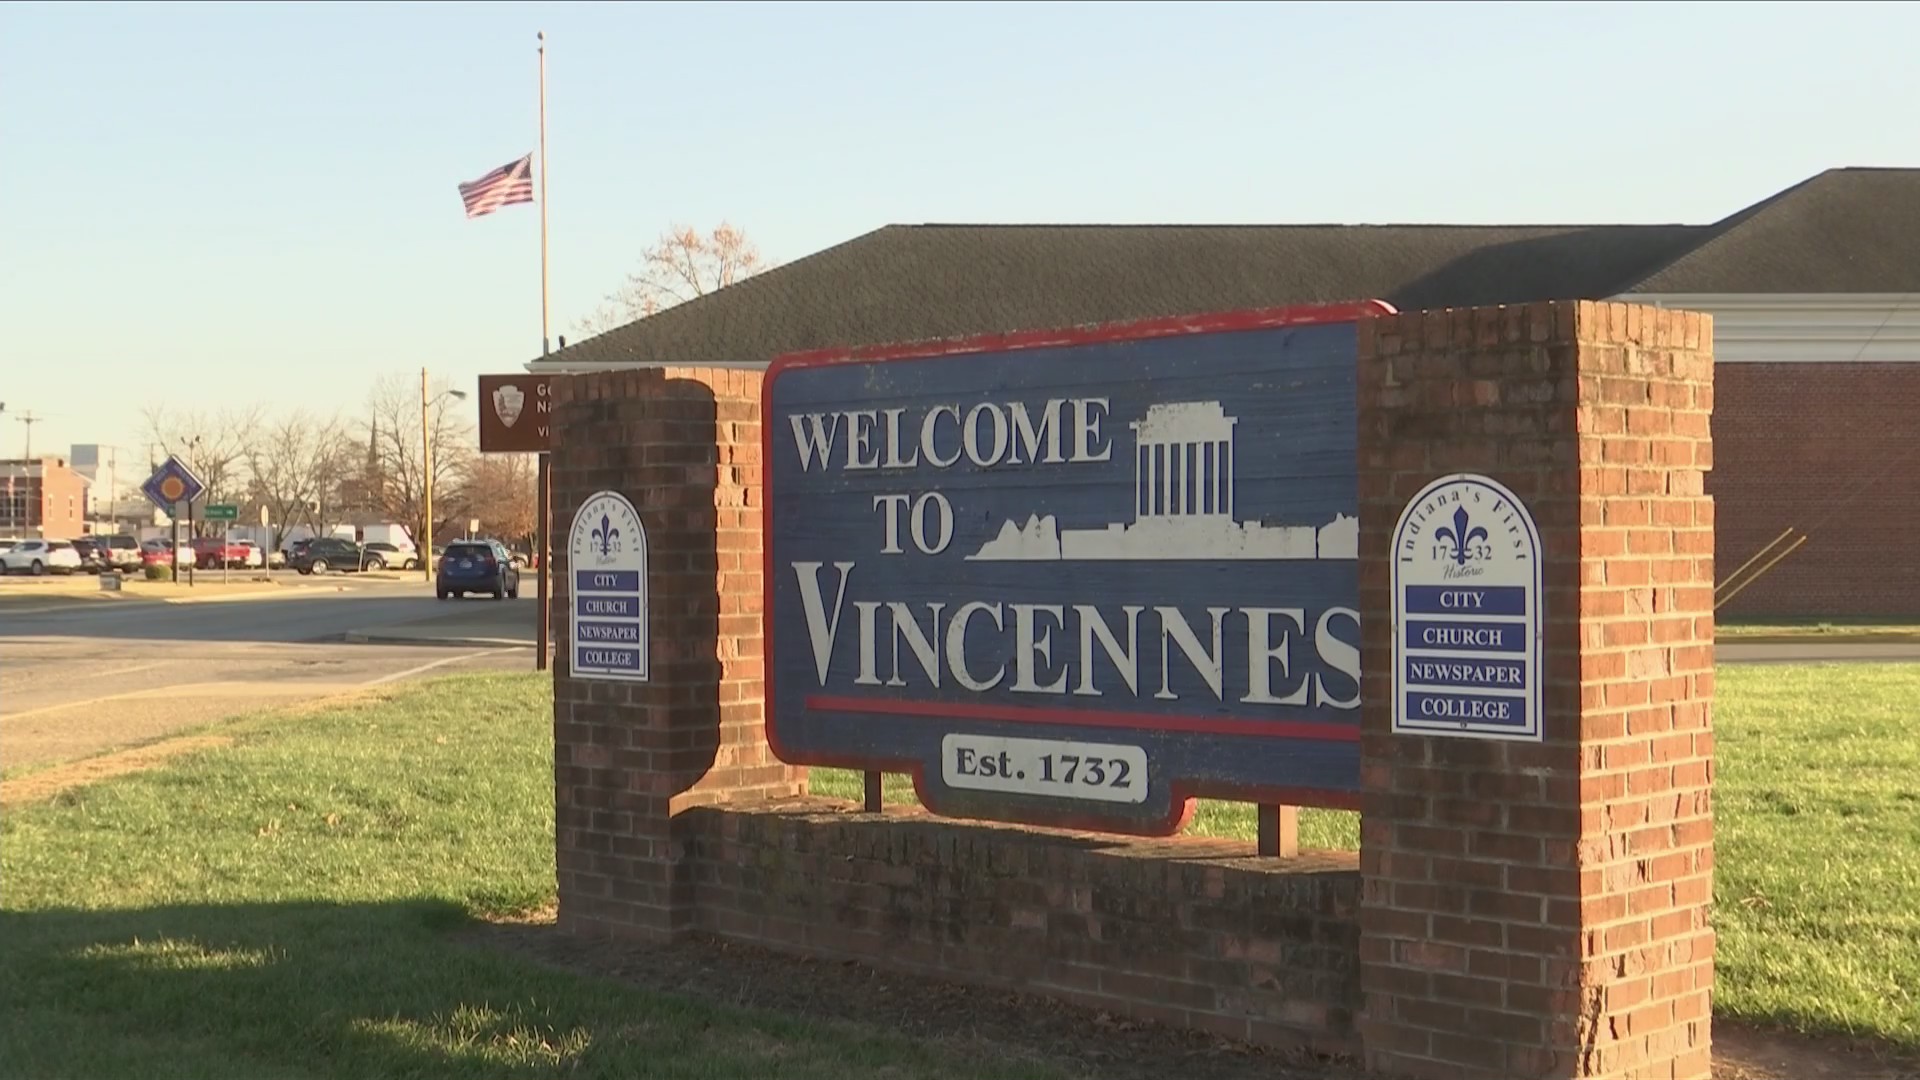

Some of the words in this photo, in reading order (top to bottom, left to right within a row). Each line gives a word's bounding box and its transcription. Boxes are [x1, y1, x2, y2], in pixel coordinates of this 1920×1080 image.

[788, 398, 1113, 472] WELCOME
[873, 491, 955, 555] TO
[1401, 485, 1481, 563] Indiana's
[1492, 499, 1527, 561] First
[593, 573, 619, 587] CITY
[1443, 563, 1485, 581] Historic
[586, 599, 628, 614] CHURCH
[1439, 591, 1485, 608] CITY
[580, 625, 638, 641] NEWSPAPER
[791, 561, 1362, 710] VINCENNES
[1422, 627, 1503, 647] CHURCH
[585, 650, 632, 666] COLLEGE
[1410, 662, 1522, 684] NEWSPAPER
[1420, 697, 1510, 720] COLLEGE
[956, 747, 1026, 781] Est.
[1039, 753, 1132, 789] 1732
